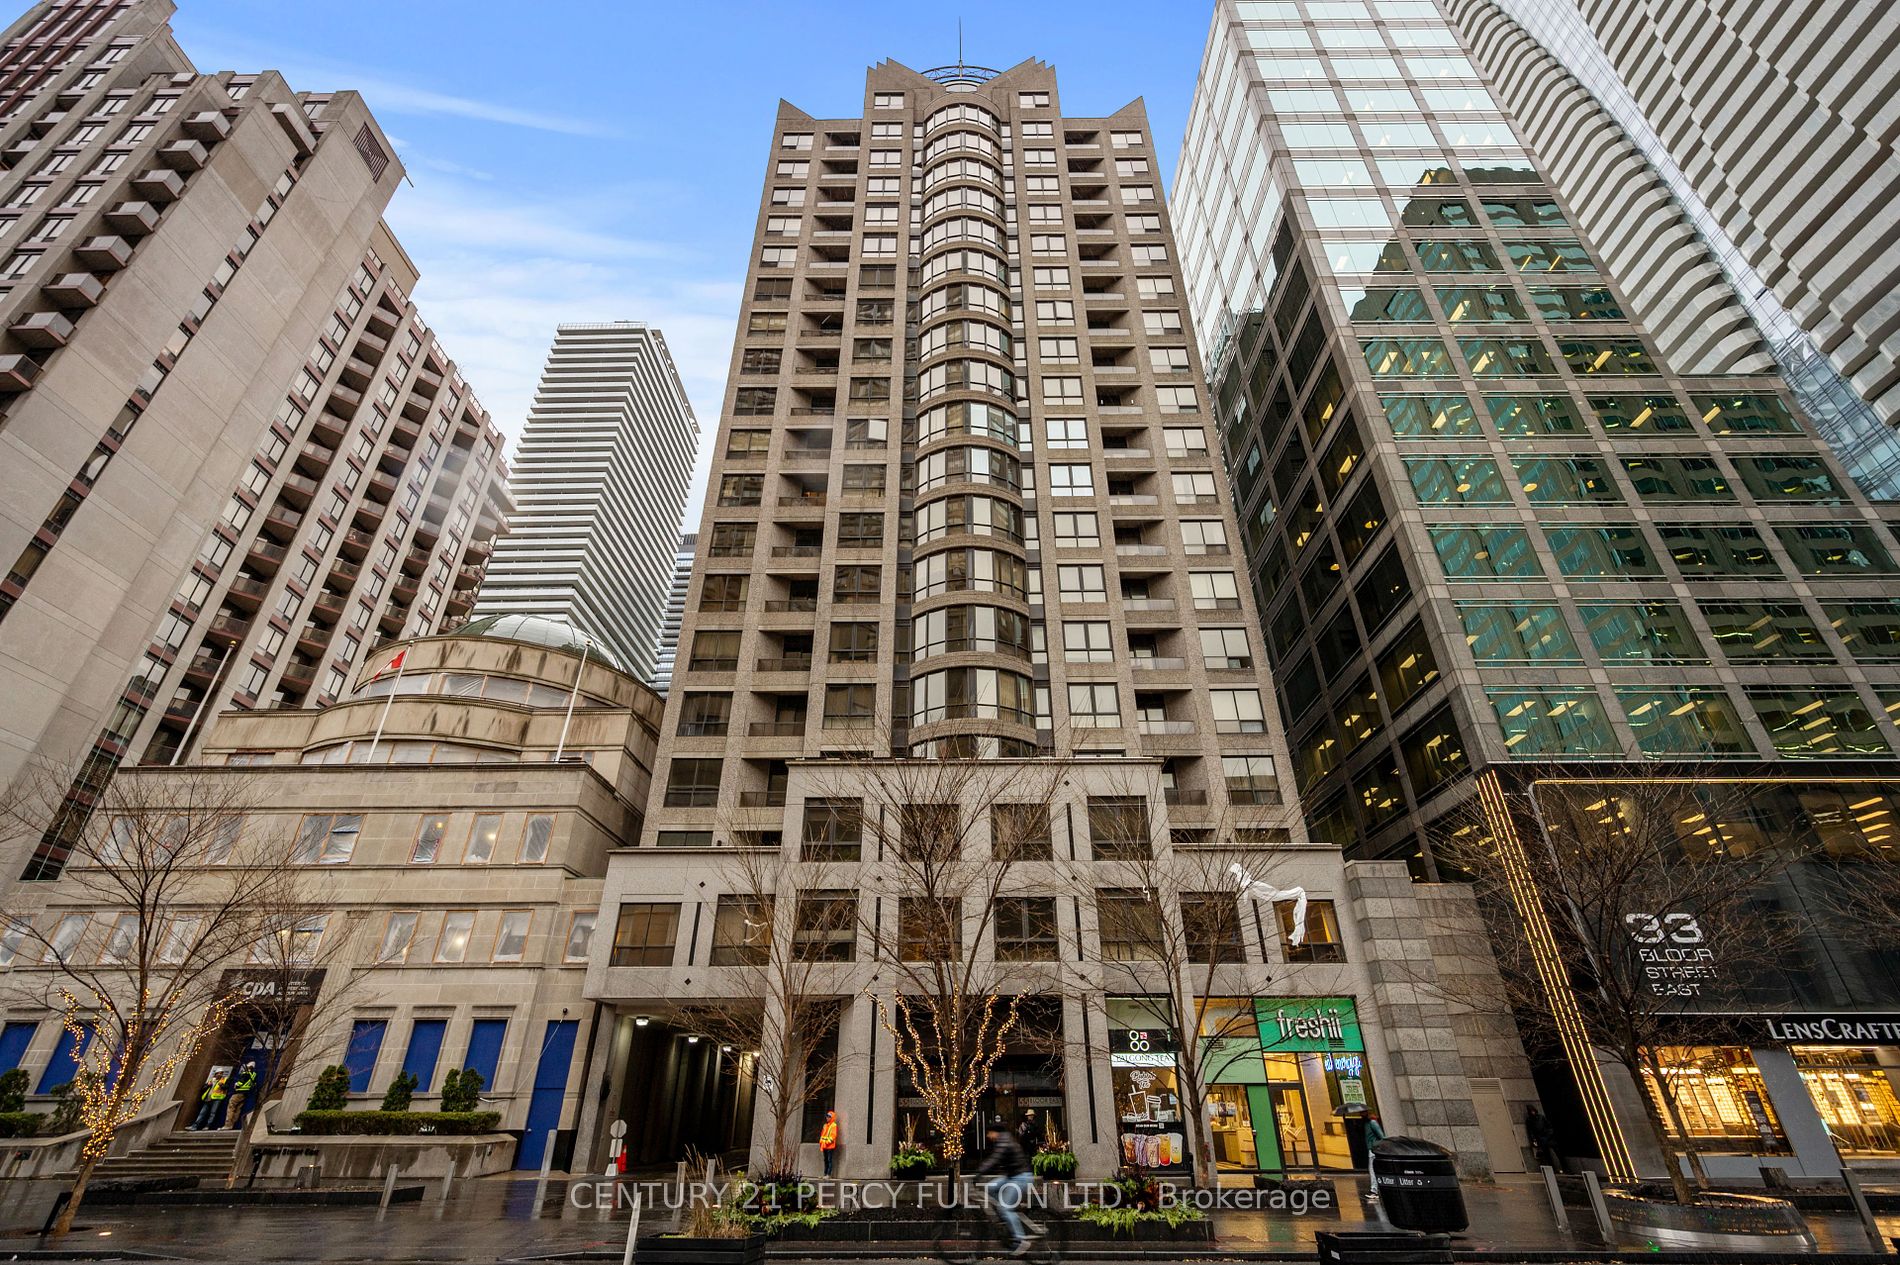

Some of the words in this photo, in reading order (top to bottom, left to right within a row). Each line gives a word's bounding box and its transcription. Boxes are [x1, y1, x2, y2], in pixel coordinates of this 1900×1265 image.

[1625, 912, 1705, 944] 33
[1639, 948, 1715, 962] BLOOR
[1646, 966, 1718, 979] STREET
[242, 981, 275, 997] CPA
[1651, 983, 1700, 996] EAST
[1277, 1008, 1343, 1039] freshii
